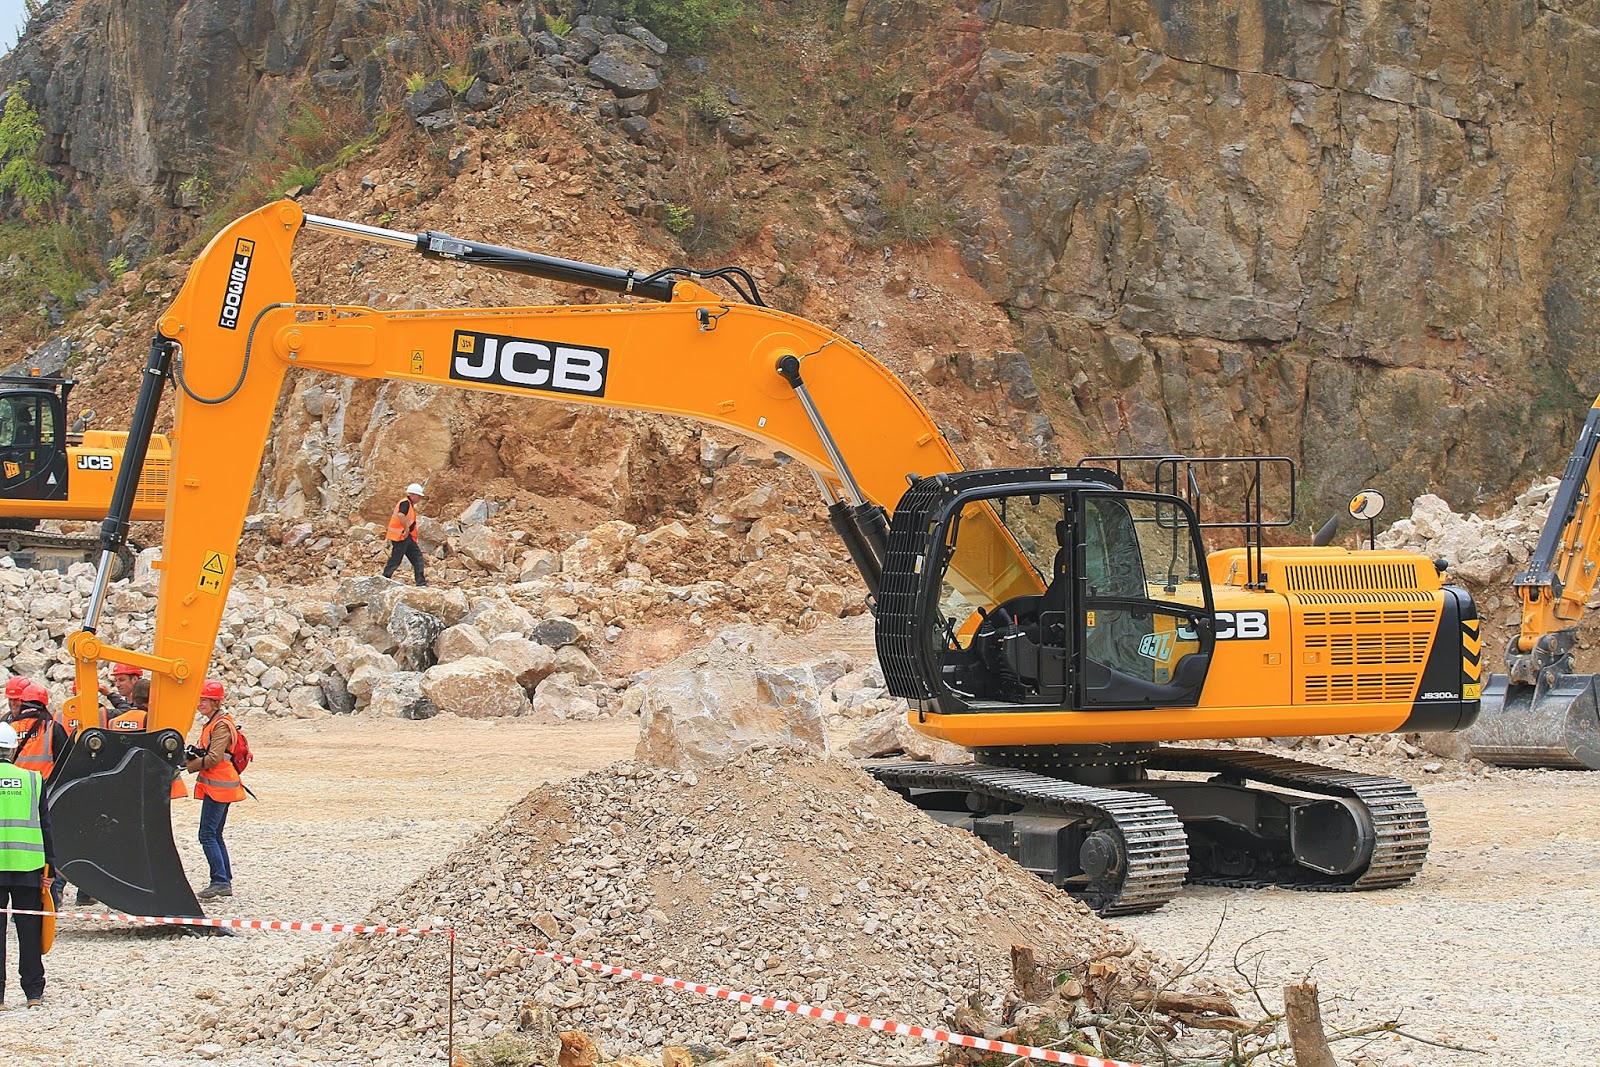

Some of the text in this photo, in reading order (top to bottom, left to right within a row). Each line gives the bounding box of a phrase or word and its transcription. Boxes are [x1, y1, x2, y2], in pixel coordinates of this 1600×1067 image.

[223, 257, 249, 320] JS300
[455, 338, 603, 391] JCB
[78, 456, 112, 469] JCB
[0, 778, 22, 788] CB
